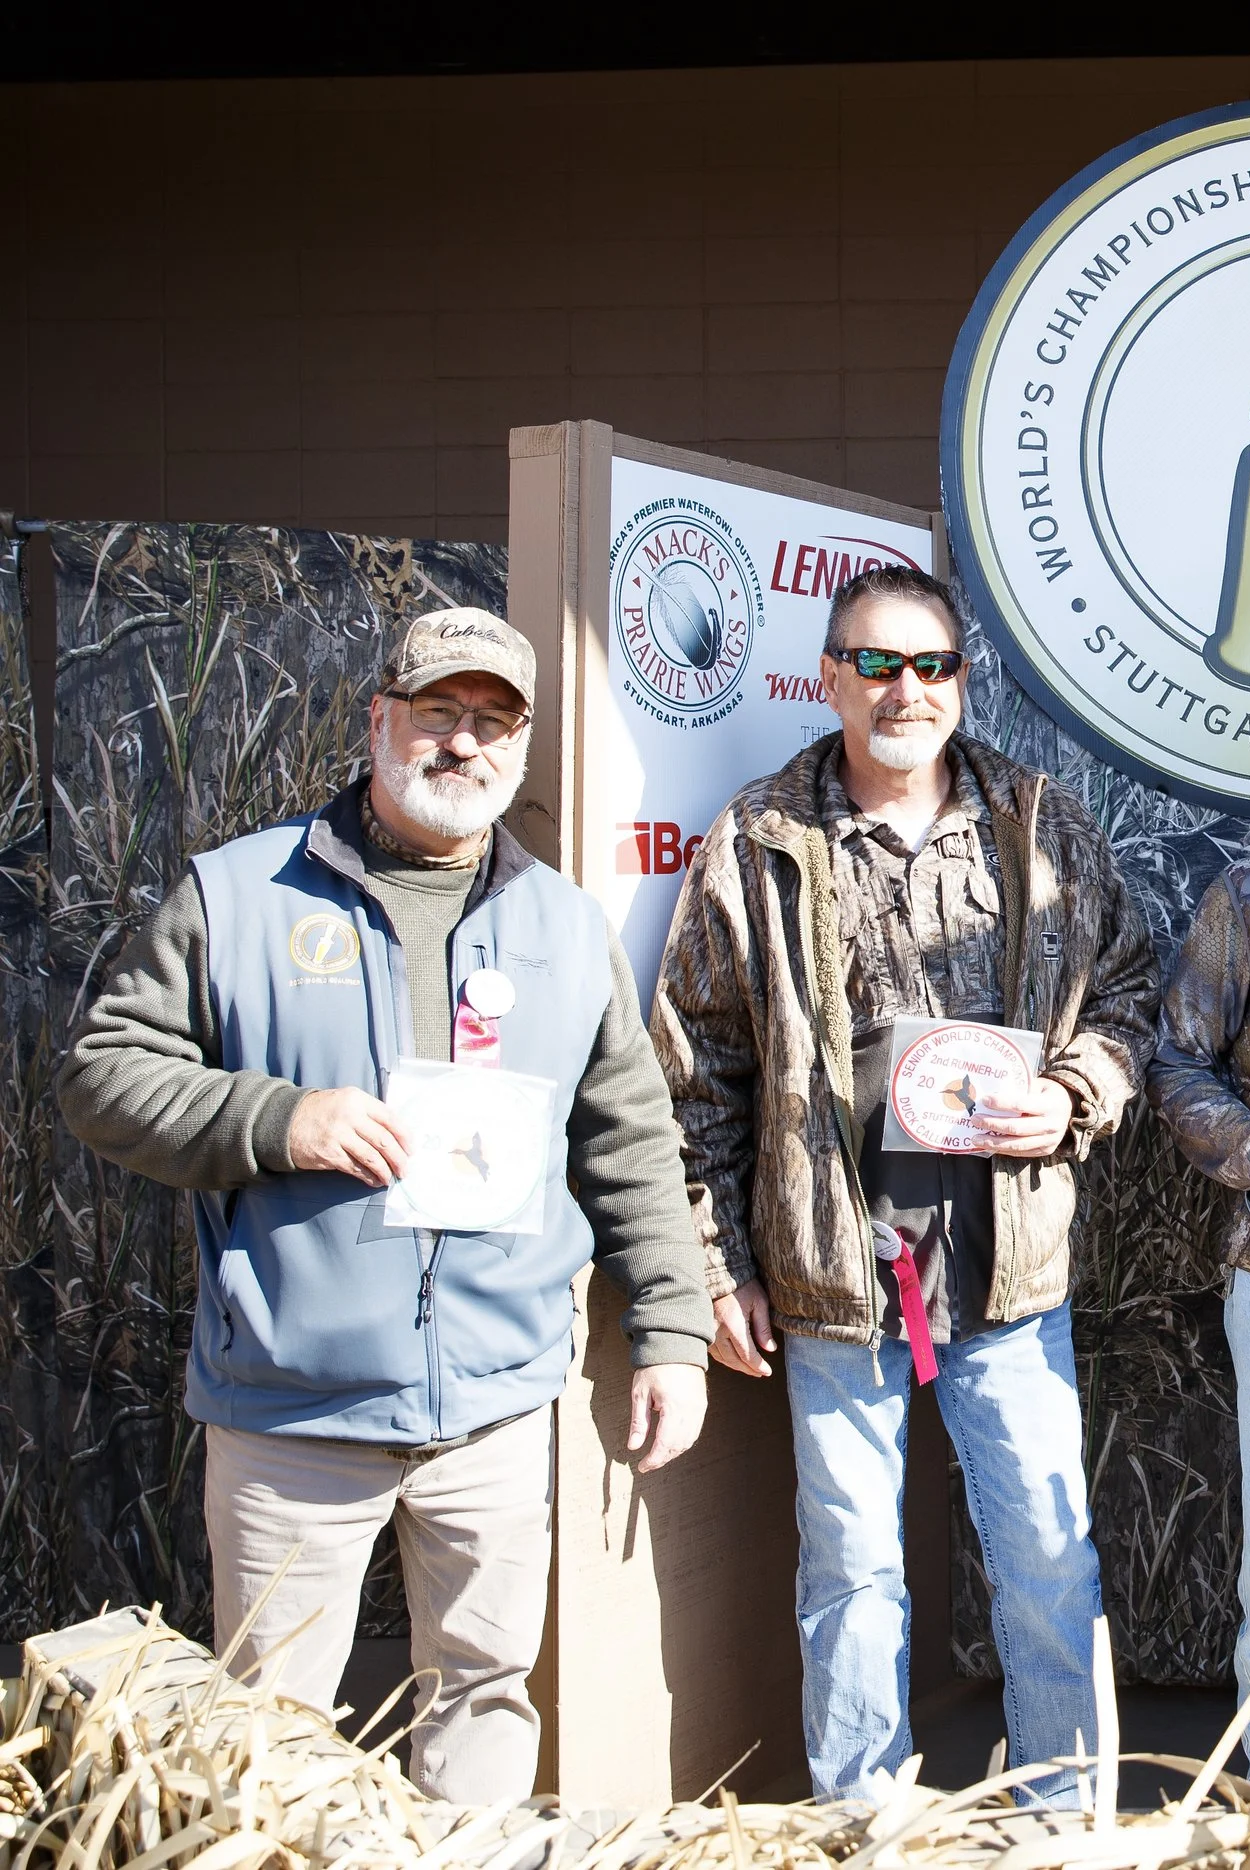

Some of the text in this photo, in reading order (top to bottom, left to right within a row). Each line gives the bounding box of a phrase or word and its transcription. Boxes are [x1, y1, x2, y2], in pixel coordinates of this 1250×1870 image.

[1018, 381, 1073, 583] WORLD'S
[634, 498, 675, 524] PREMIER
[678, 498, 733, 539] WATERFOWL
[734, 537, 764, 612] OUTFITTER
[642, 529, 730, 582] MACK'S
[770, 540, 889, 600] LENN
[624, 606, 746, 700] PRAIRIE WINGS
[624, 680, 743, 730] STUTTGART, ARKANSAS
[902, 1043, 931, 1079] SENIOR
[931, 1030, 981, 1047] WORLD'S
[930, 1054, 1008, 1079] 2nd RUNNER-UP
[917, 1075, 935, 1089] 20
[900, 1097, 960, 1147] DUCK CALLING
